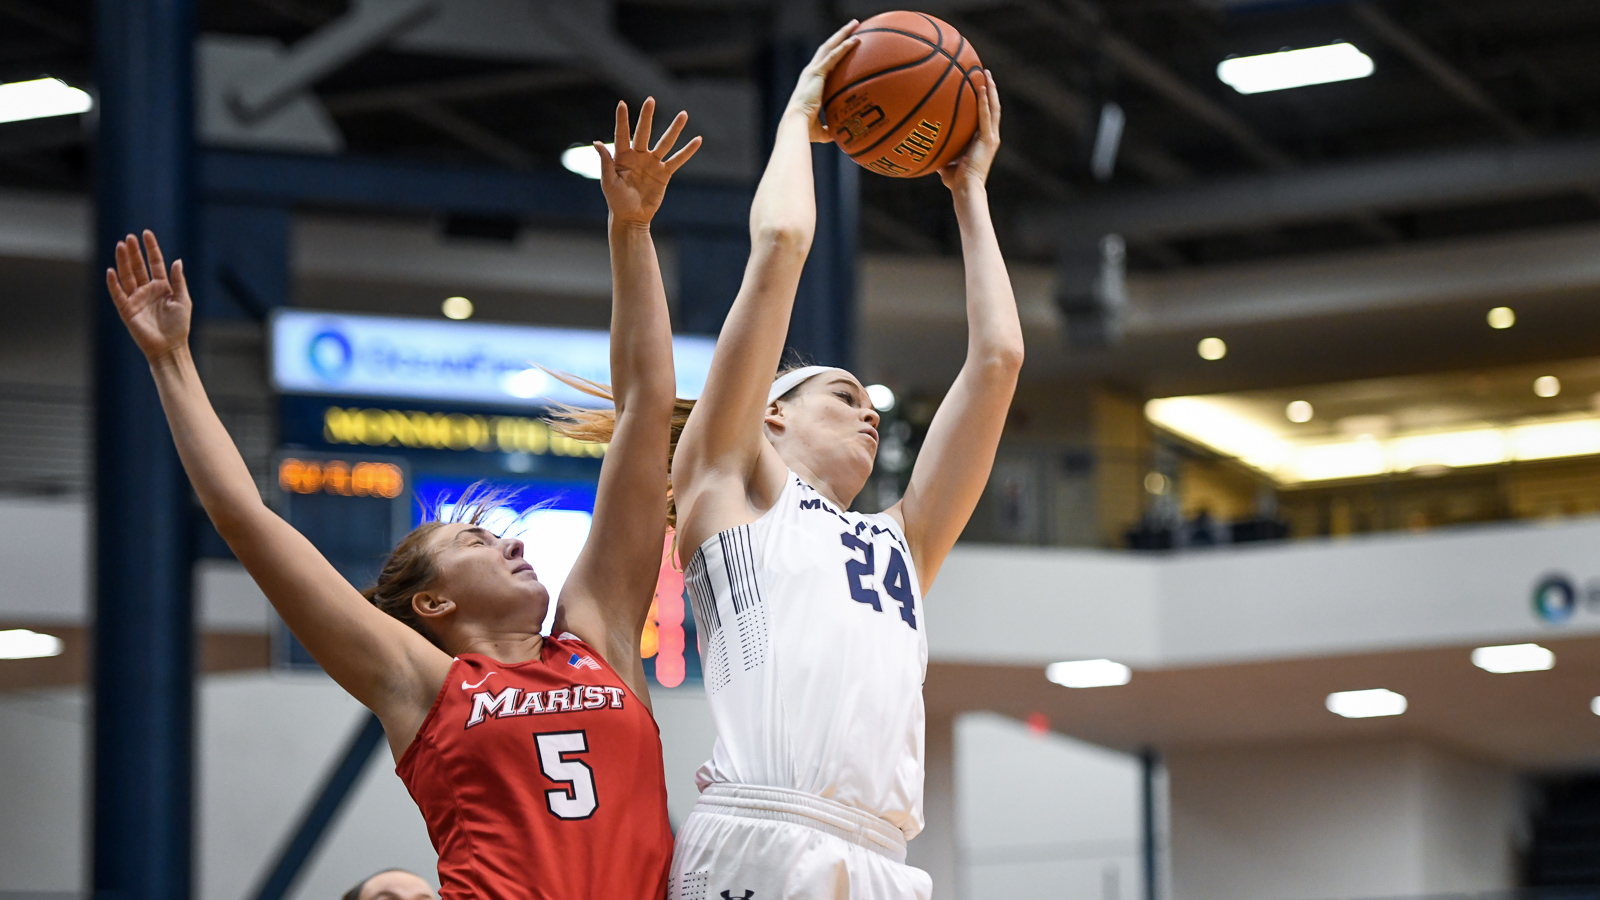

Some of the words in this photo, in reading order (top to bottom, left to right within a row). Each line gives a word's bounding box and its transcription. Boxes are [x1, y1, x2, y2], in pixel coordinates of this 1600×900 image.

[836, 105, 886, 145] C2C
[892, 119, 941, 163] THE
[840, 531, 917, 631] 24
[464, 684, 626, 730] MARIST
[532, 729, 600, 821] 5
